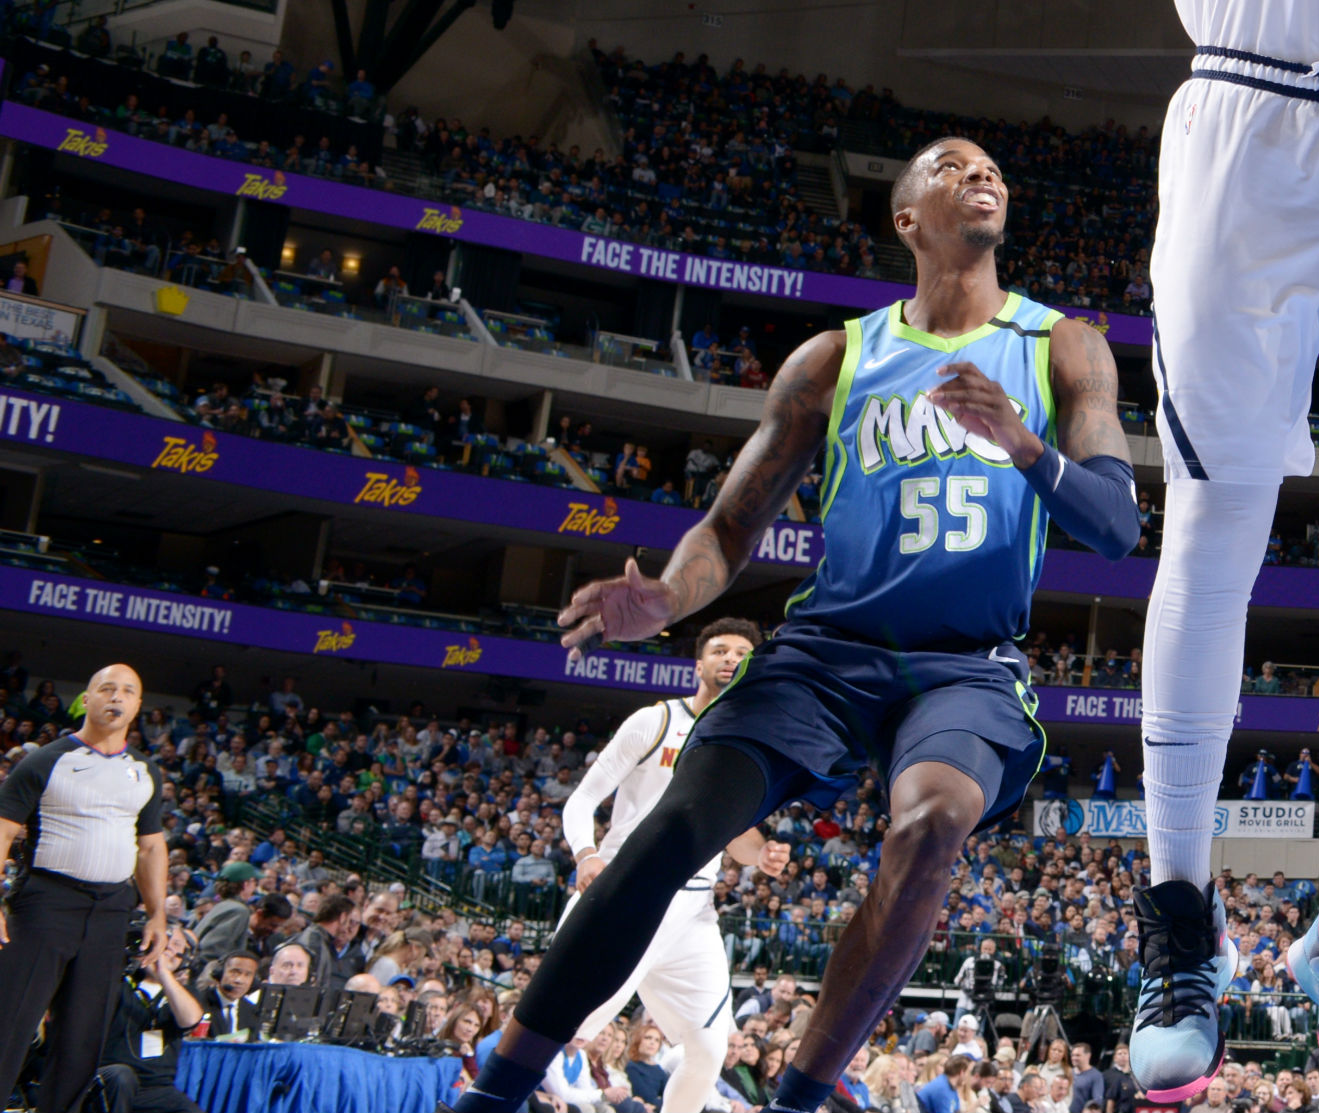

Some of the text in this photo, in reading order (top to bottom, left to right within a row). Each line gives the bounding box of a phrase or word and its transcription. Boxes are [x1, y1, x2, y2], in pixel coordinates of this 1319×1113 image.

[59, 128, 108, 156] Takis
[416, 207, 464, 234] Takis
[581, 236, 803, 298] FACE THE INTENSITY!
[151, 436, 219, 473] Takis
[558, 502, 619, 536] Takis
[900, 475, 988, 555] 55
[28, 581, 233, 634] FACE THE INTENSITY!
[563, 654, 608, 678] FACE
[613, 658, 647, 682] THE
[1065, 695, 1106, 717] FACE
[1239, 806, 1306, 818] STUDIO
[1239, 819, 1306, 827] MOVIE GRILL
